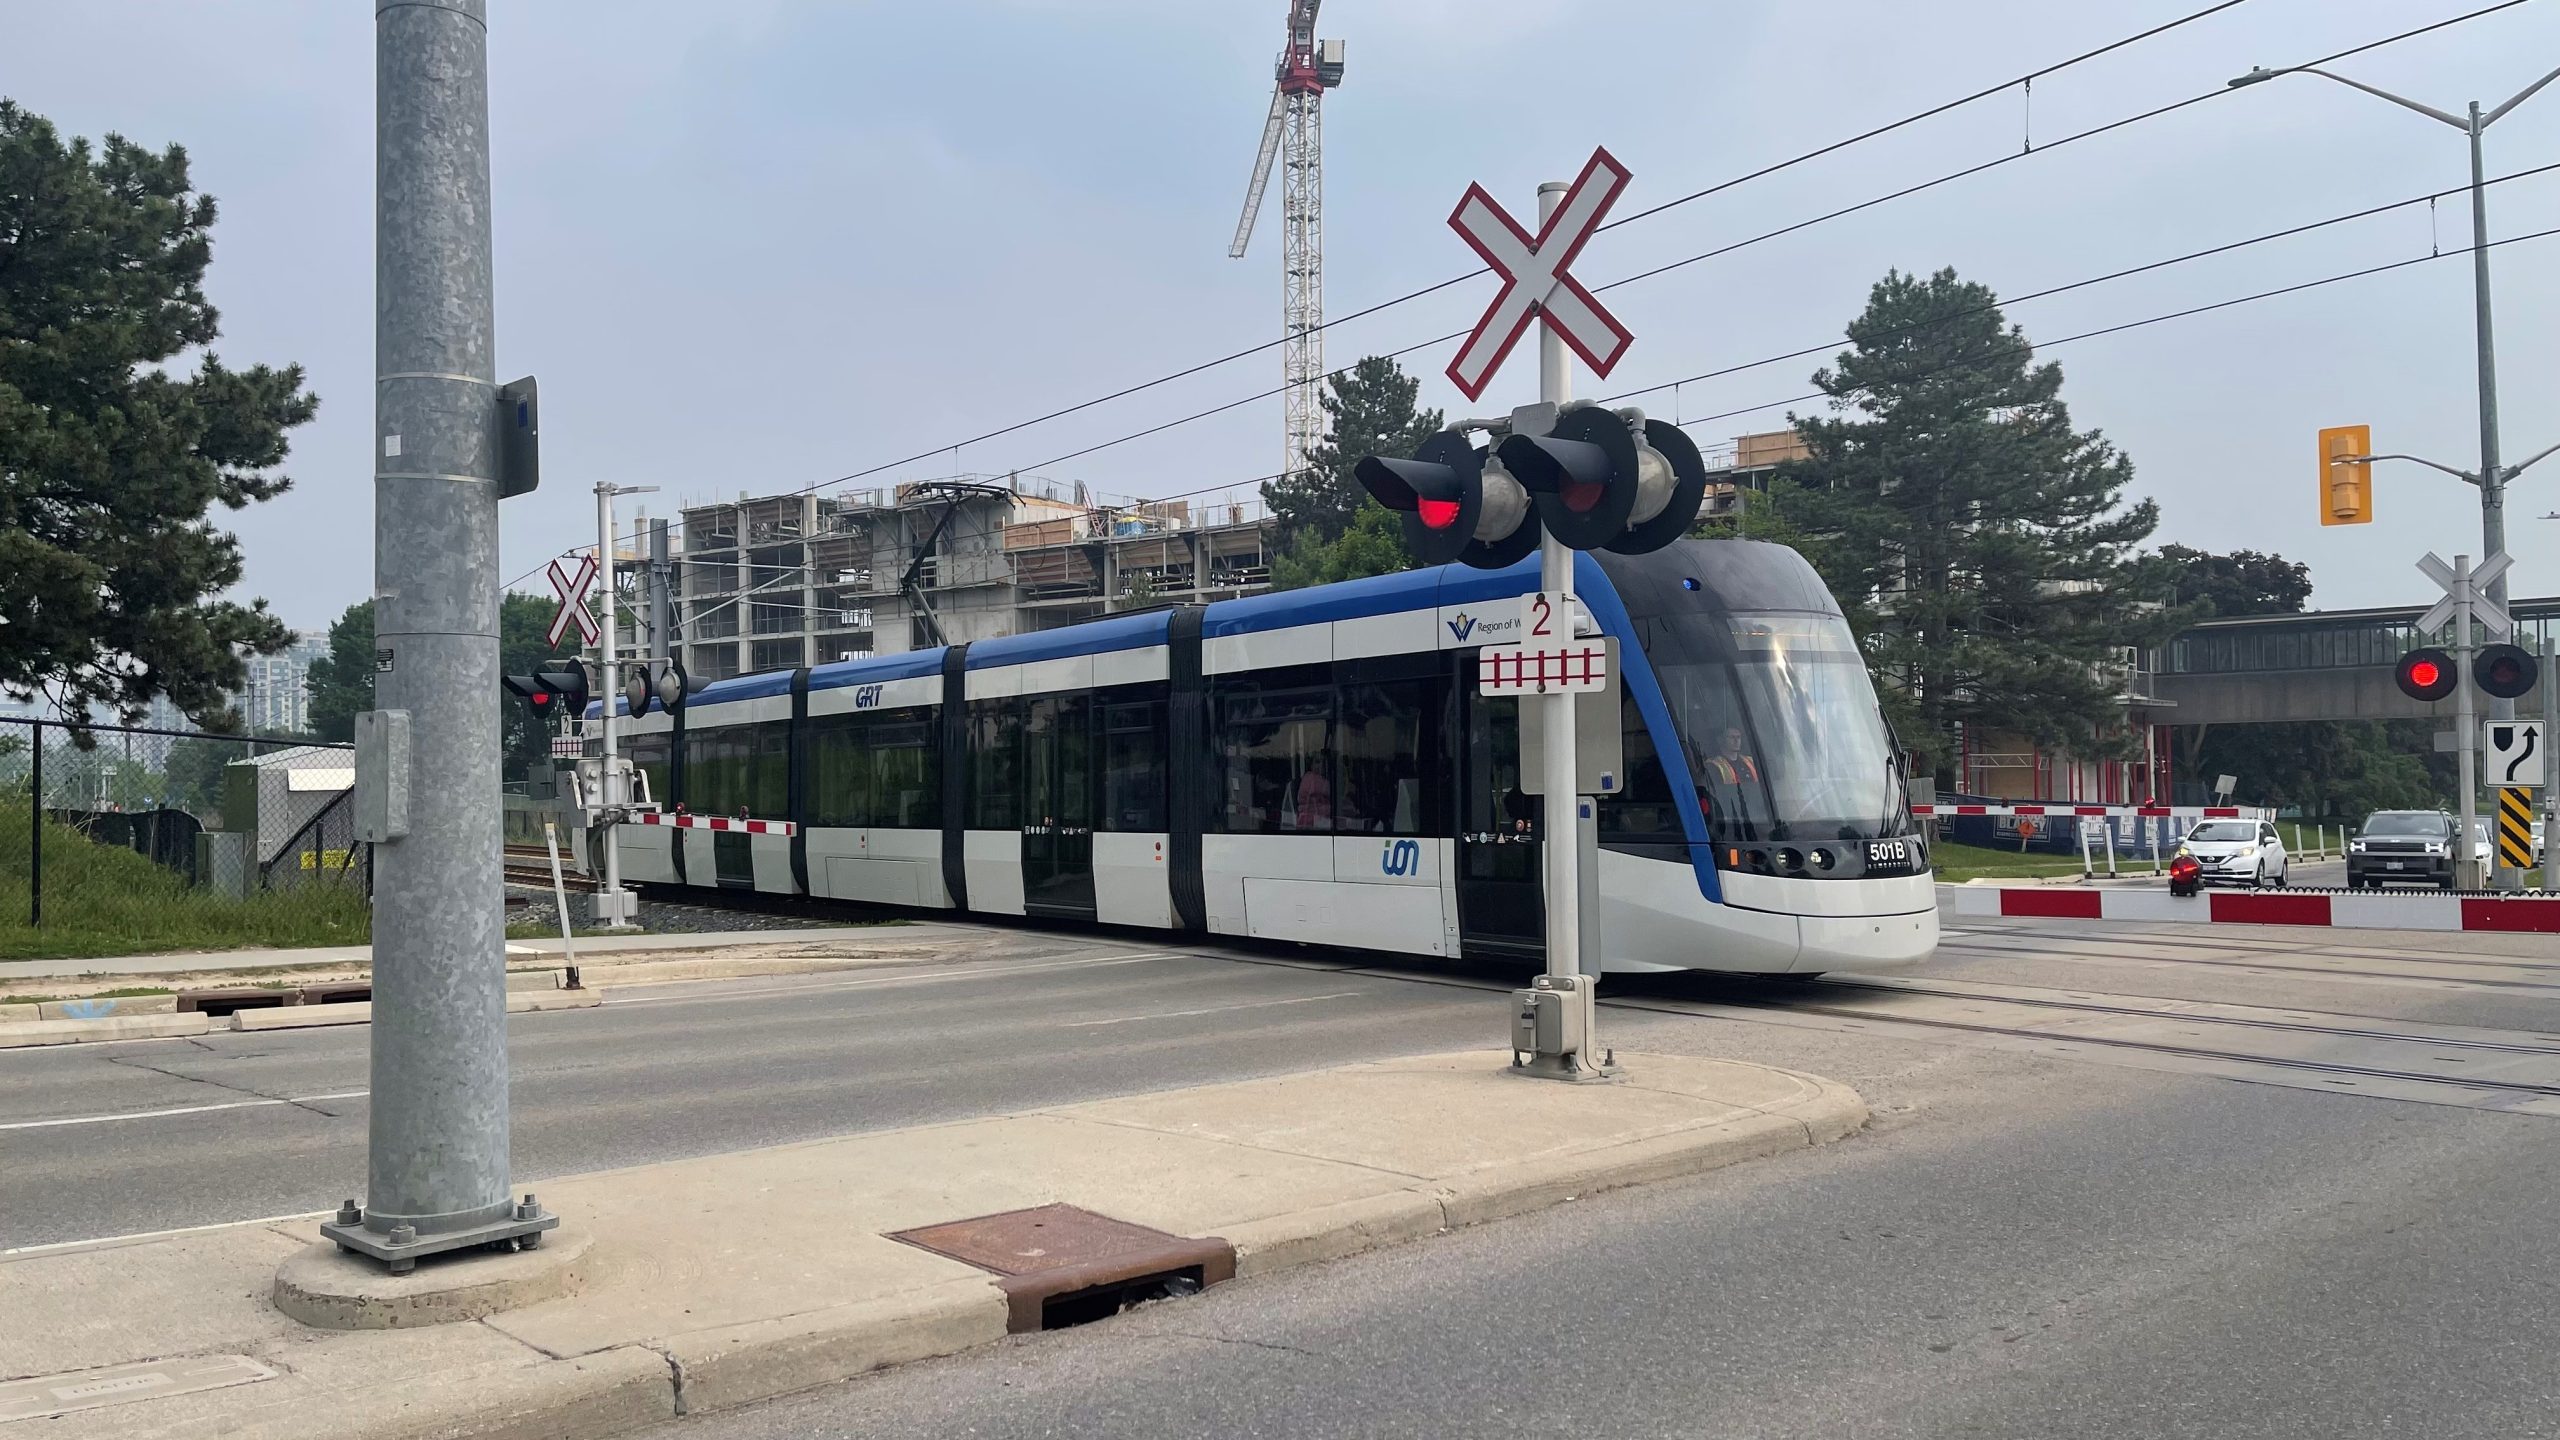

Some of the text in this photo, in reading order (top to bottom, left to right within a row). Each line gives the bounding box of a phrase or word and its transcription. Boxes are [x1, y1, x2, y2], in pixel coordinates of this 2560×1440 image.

[1477, 622, 1504, 634] Region
[1504, 618, 1513, 629] of
[1532, 600, 1551, 636] 2
[856, 684, 883, 708] GRT
[1870, 842, 1905, 861] 501B
